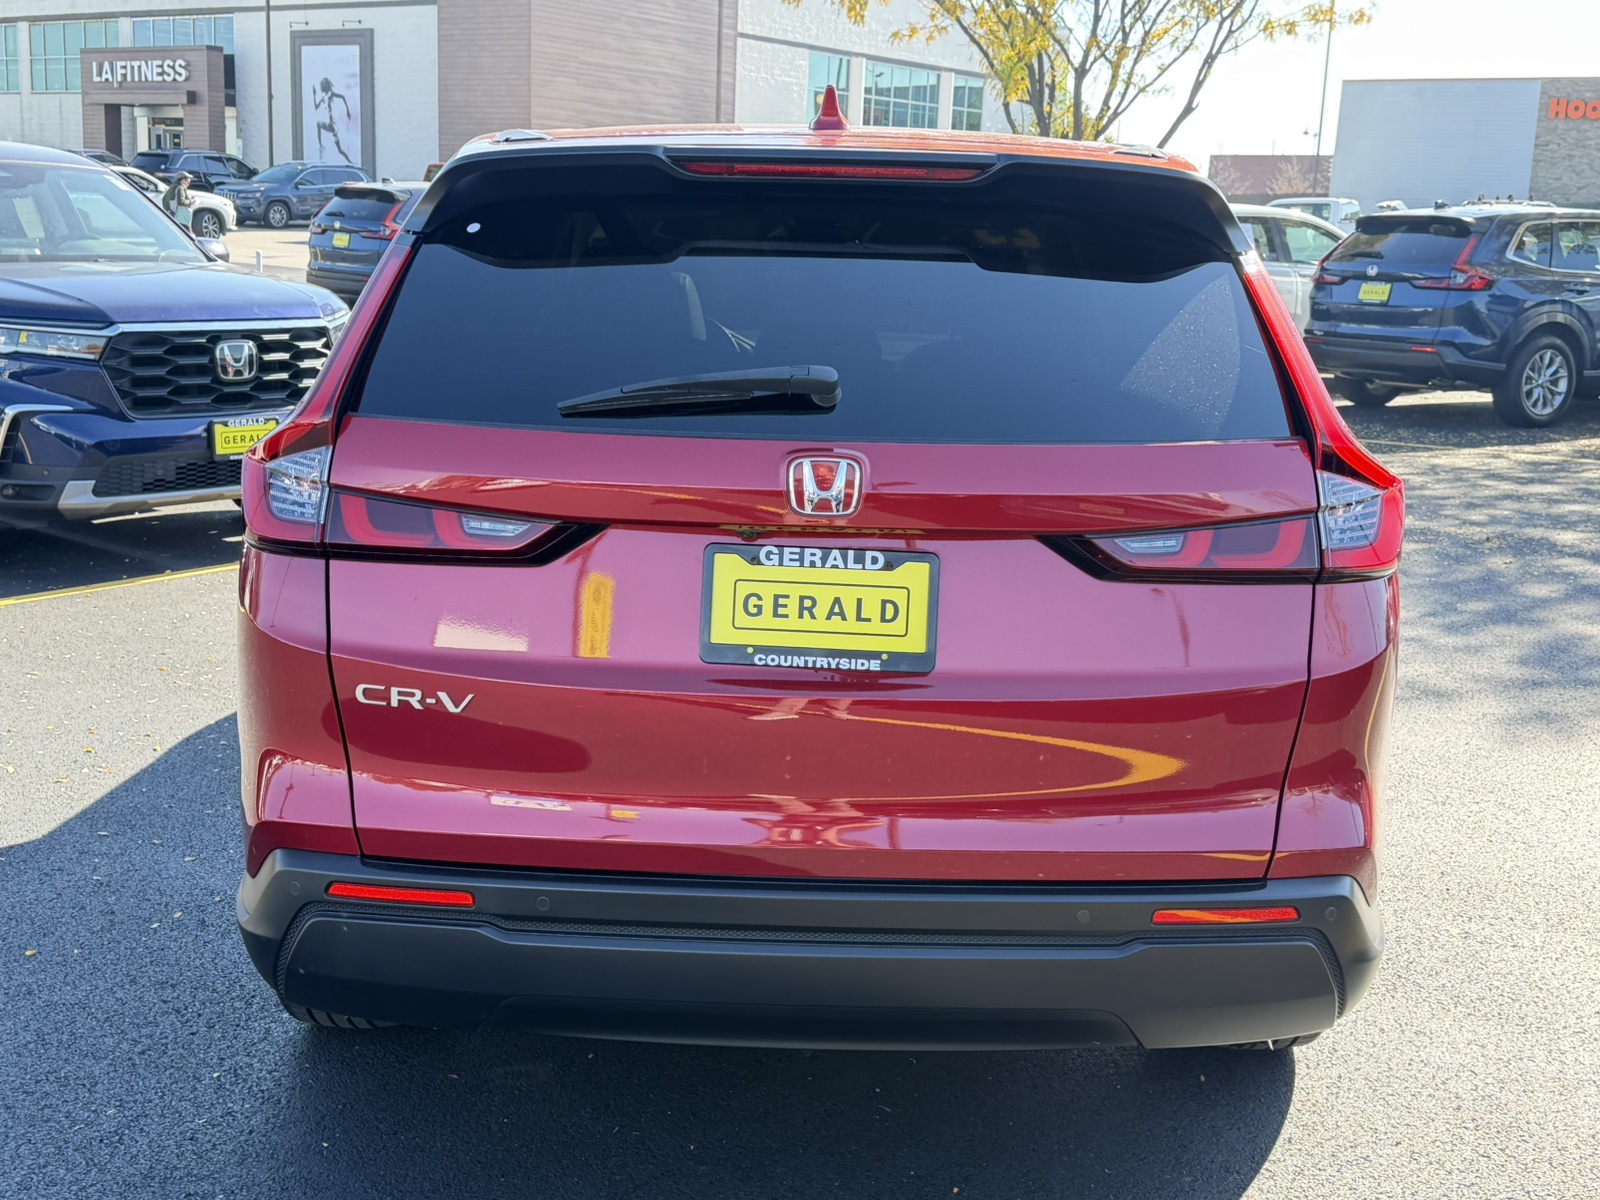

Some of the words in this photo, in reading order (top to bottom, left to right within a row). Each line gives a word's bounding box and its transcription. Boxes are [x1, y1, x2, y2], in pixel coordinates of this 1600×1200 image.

[92, 61, 113, 82] LA
[116, 59, 187, 82] FITNESS
[1548, 98, 1600, 120] HOO
[228, 417, 265, 427] GERALD
[223, 433, 261, 445] GERAL
[759, 545, 885, 570] GERALD
[742, 592, 900, 624] GERALD
[753, 653, 881, 671] COUNTRYSIDE
[355, 683, 475, 714] CR-V
